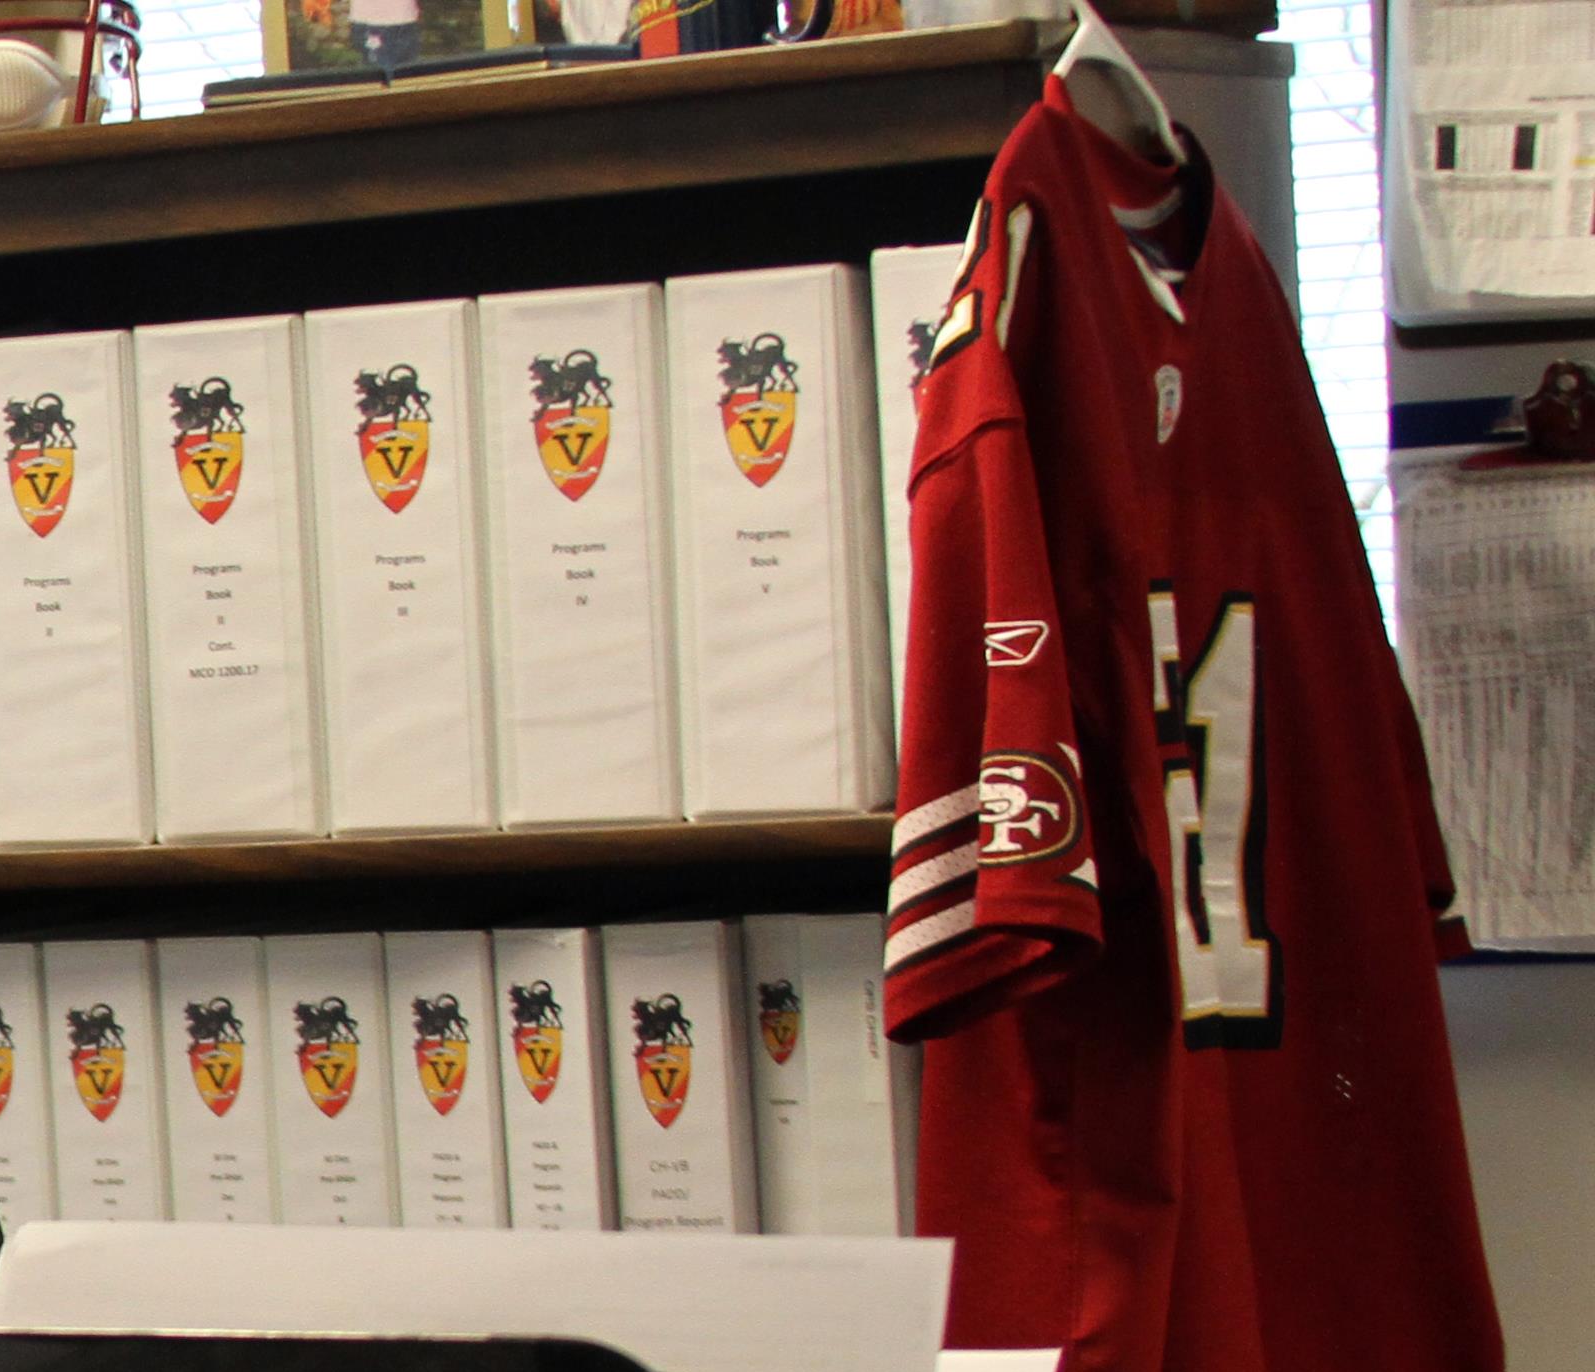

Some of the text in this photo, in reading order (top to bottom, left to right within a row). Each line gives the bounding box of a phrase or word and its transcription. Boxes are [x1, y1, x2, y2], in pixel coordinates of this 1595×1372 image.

[739, 417, 778, 451] V
[553, 432, 593, 465] V
[377, 446, 413, 478] V
[193, 457, 228, 489] V
[25, 472, 59, 503] V
[737, 530, 791, 542] Programs
[552, 543, 606, 555] Programs
[375, 555, 426, 566] Programs
[750, 556, 779, 567] Book
[193, 565, 242, 576] Programs
[566, 569, 595, 580] Book
[24, 578, 71, 588] Programs
[389, 581, 415, 591] Book
[206, 590, 232, 600] Book
[36, 602, 61, 612] Book
[208, 641, 236, 652] Cont.
[771, 1025, 791, 1044] V
[526, 1048, 552, 1075] V
[86, 1070, 112, 1095] V
[204, 1063, 231, 1090] V
[314, 1063, 344, 1090] V
[429, 1061, 456, 1088] V
[650, 1068, 679, 1097] V
